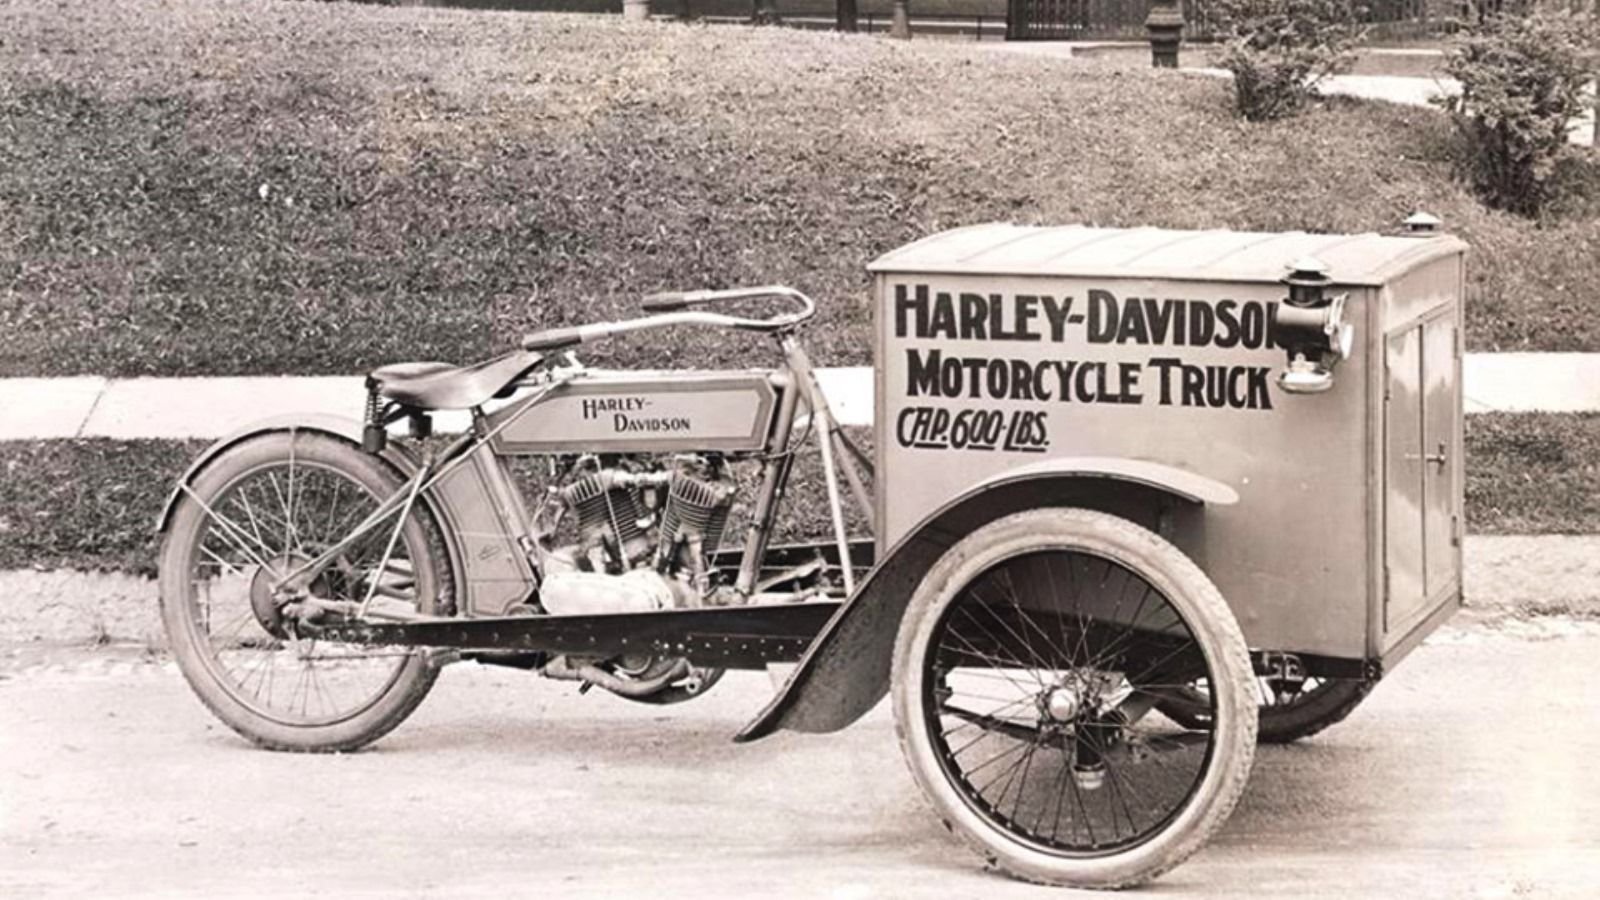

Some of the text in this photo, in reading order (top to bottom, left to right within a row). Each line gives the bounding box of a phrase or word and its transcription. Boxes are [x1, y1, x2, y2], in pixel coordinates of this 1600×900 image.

[906, 348, 1273, 410] MOTORCYCLE TRUCK
[582, 397, 653, 420] HARLEY-
[613, 413, 690, 433] DAVIDSON
